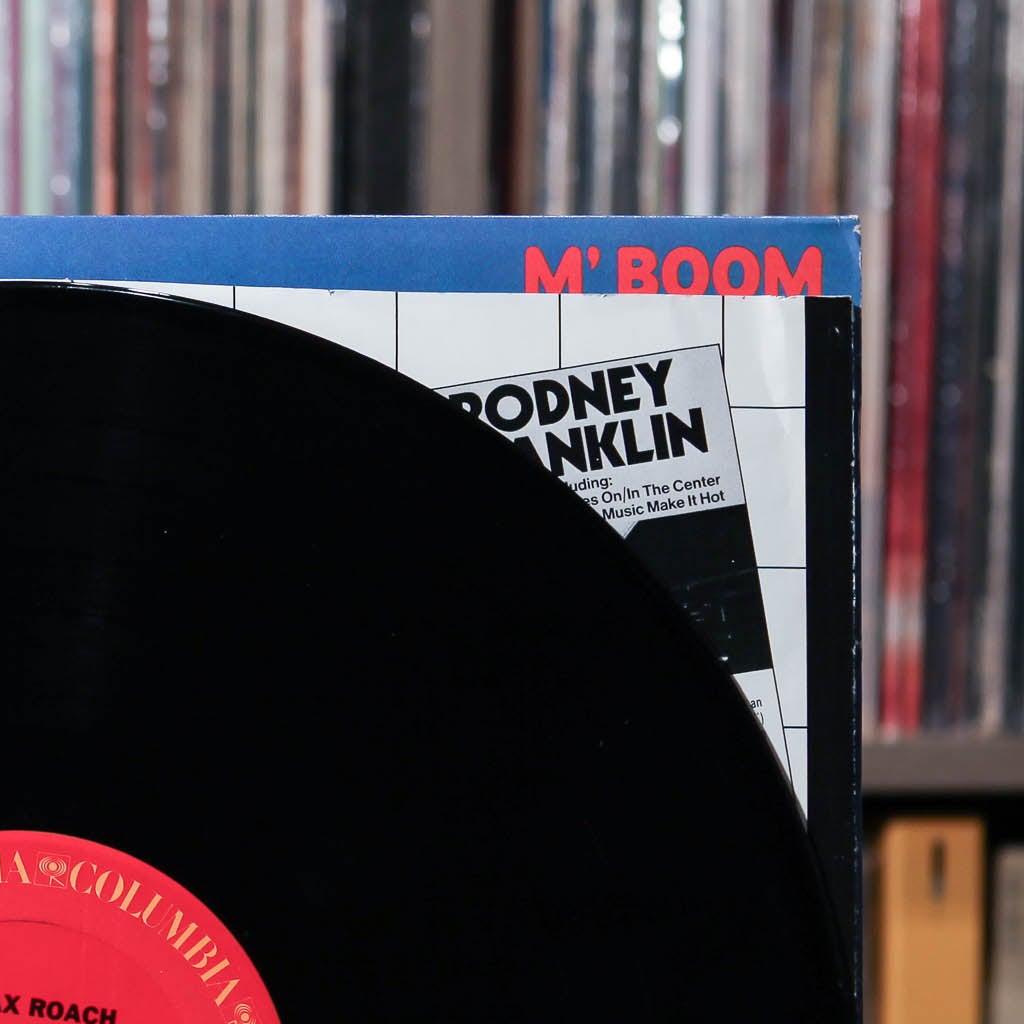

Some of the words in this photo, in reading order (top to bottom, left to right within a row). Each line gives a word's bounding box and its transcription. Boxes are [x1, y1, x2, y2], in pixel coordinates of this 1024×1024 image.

[524, 245, 601, 294] M'
[616, 245, 824, 297] BOOM
[602, 485, 641, 505] On/In
[642, 483, 670, 498] The
[673, 475, 721, 492] Center
[602, 503, 644, 521] Music
[647, 496, 685, 513] Make
[688, 493, 697, 507] It
[700, 490, 726, 505] Hot
[69, 861, 240, 1007] COLUMBIA
